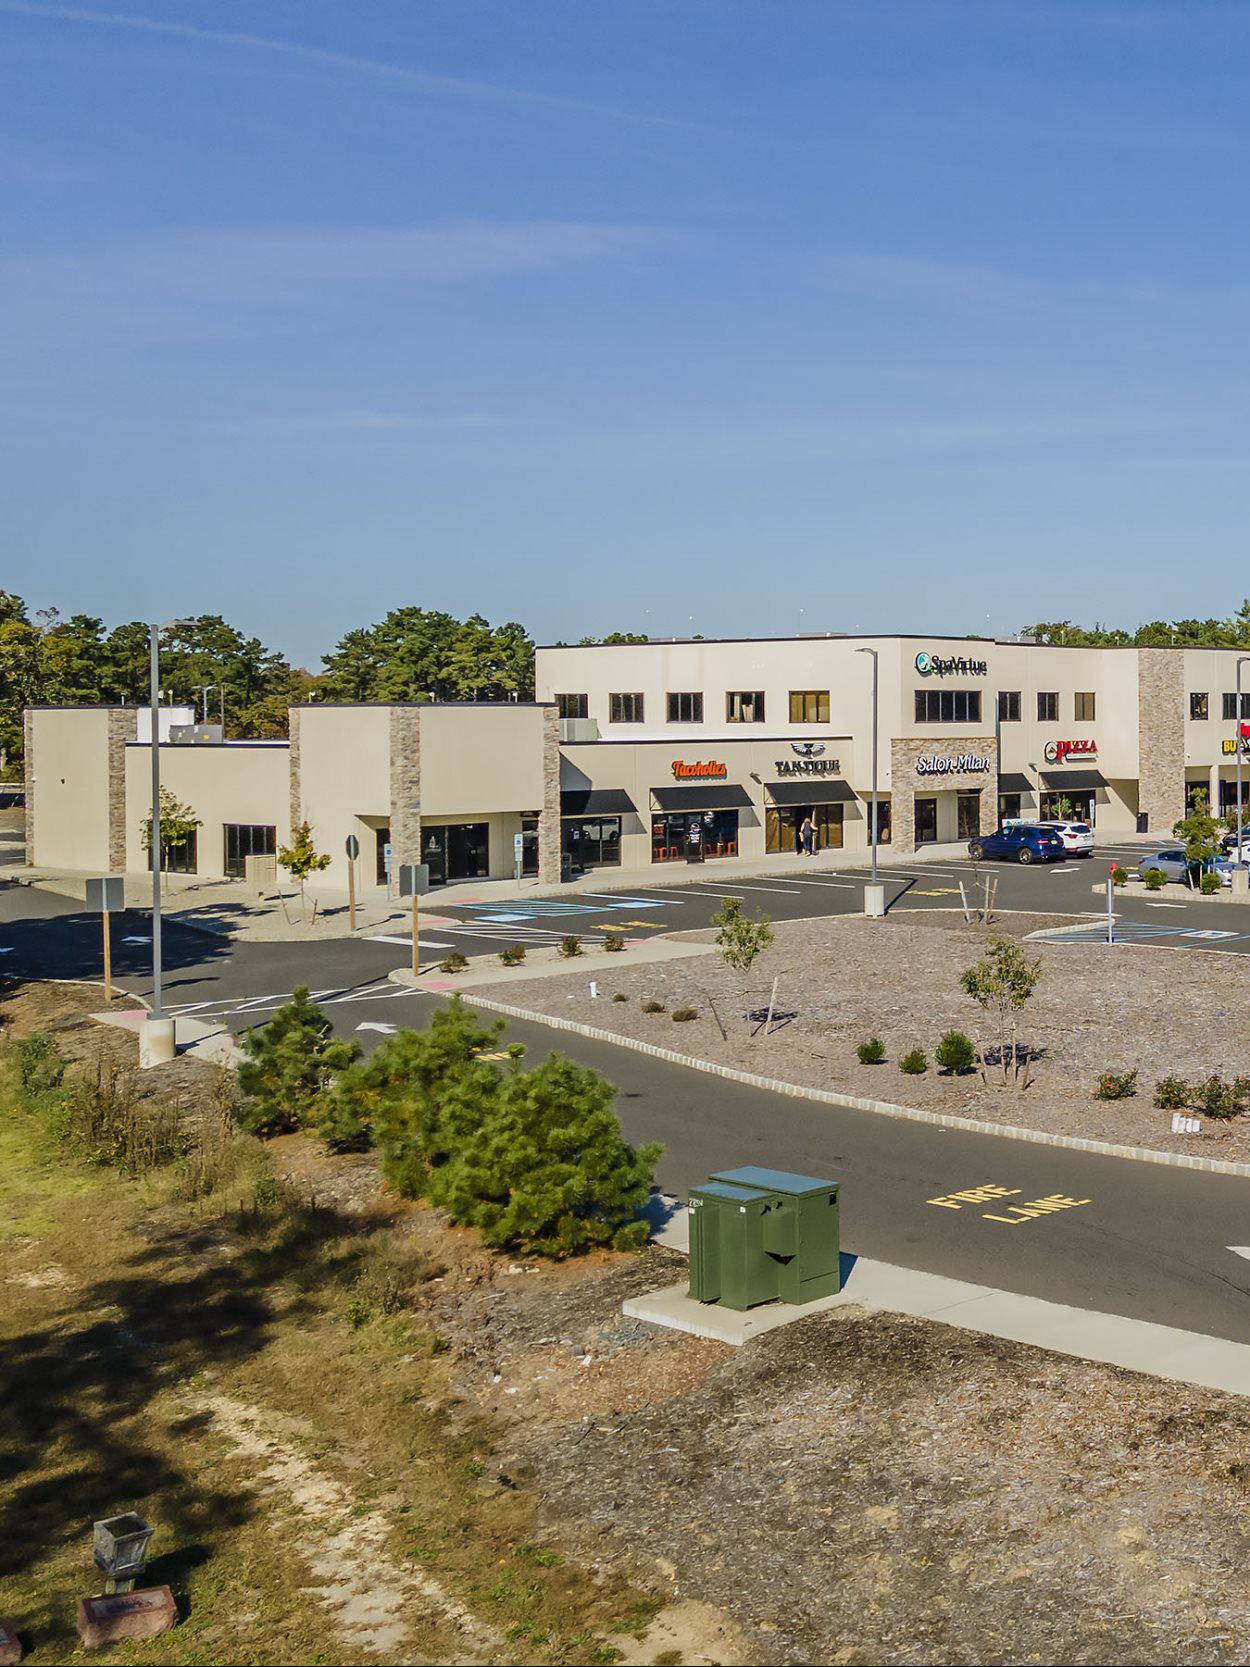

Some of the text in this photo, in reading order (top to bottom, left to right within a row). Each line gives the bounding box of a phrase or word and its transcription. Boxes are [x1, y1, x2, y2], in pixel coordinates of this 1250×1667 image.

[931, 655, 987, 677] SpaVirtue
[1057, 740, 1098, 760] PIZZA
[672, 760, 727, 778] Tacoholics
[917, 754, 990, 774] Salon Milan
[926, 1184, 1022, 1209] FIRE
[982, 1194, 1092, 1224] LANE
